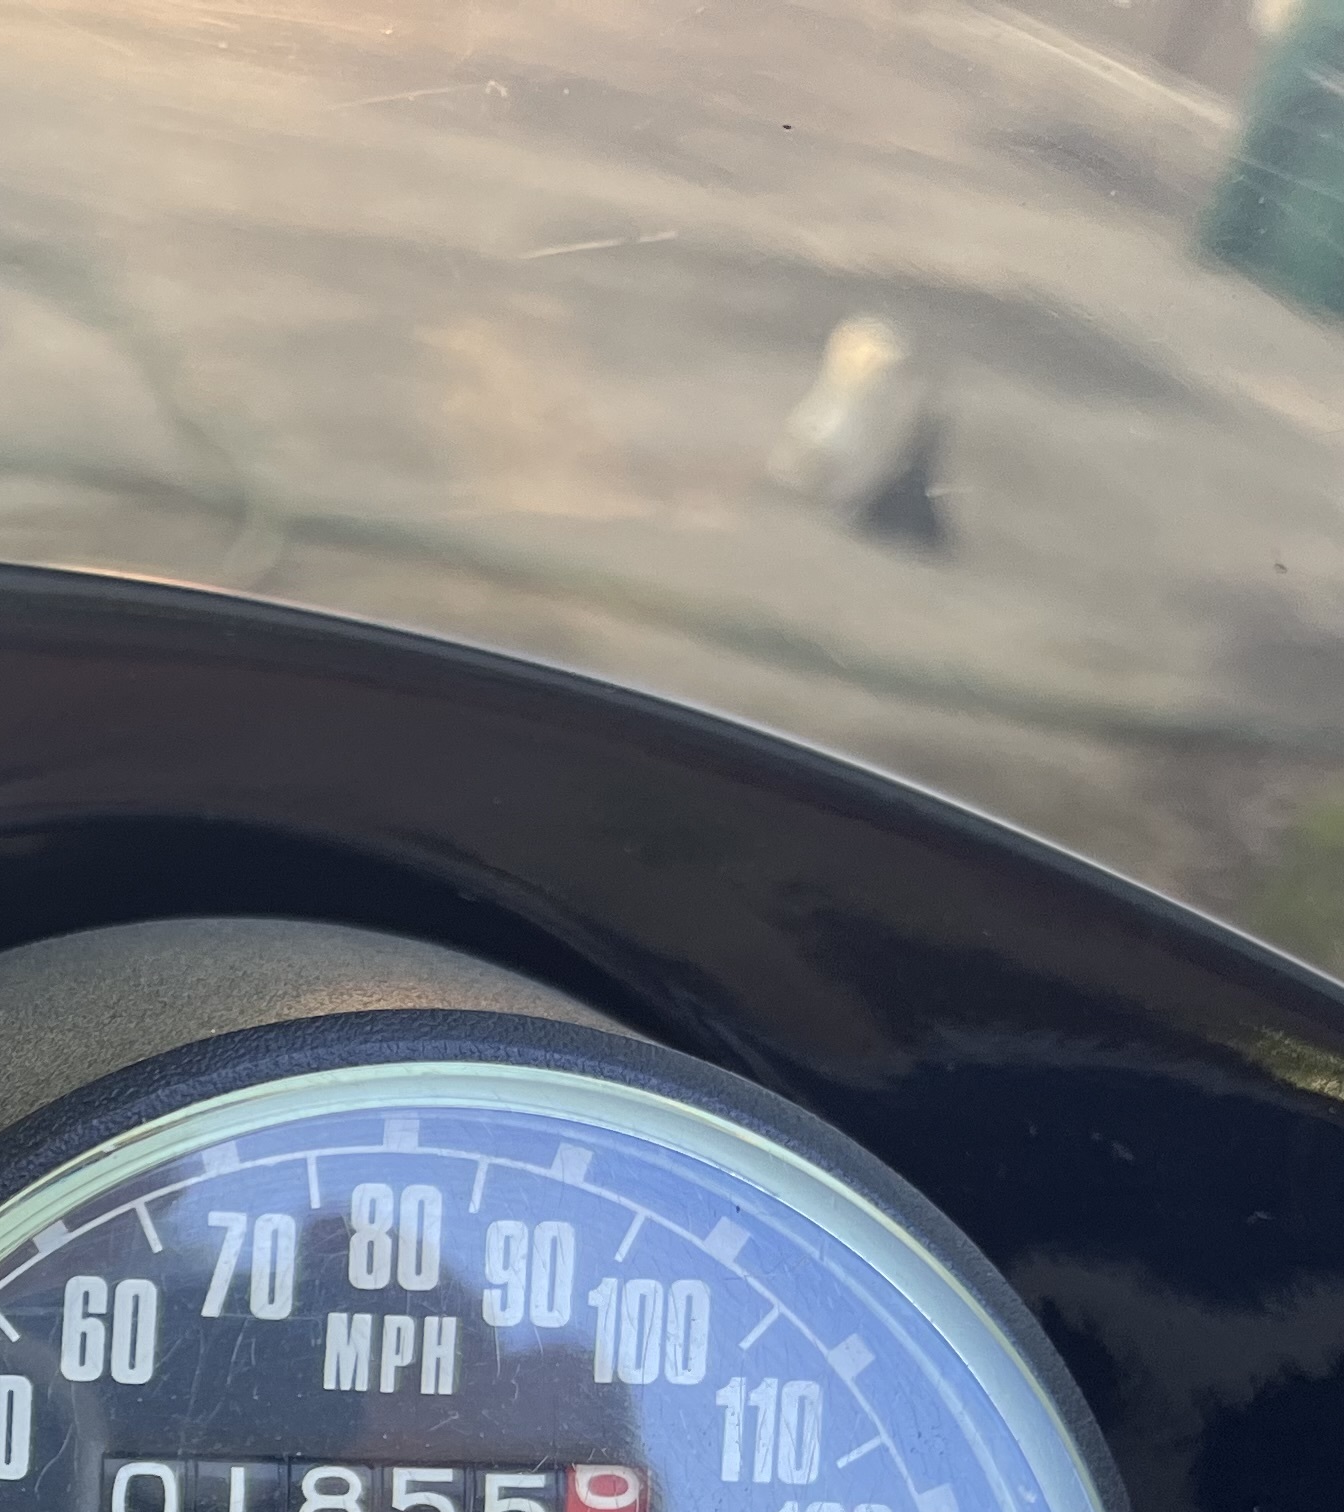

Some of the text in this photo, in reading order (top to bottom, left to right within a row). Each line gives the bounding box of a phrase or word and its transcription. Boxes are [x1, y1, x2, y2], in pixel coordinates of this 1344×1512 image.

[201, 1211, 296, 1320] 70
[348, 1183, 443, 1291] 80
[483, 1220, 575, 1327] 90
[60, 1275, 158, 1385] 60
[324, 1312, 457, 1395] MPH
[588, 1278, 709, 1385] 100
[715, 1376, 823, 1484] 110
